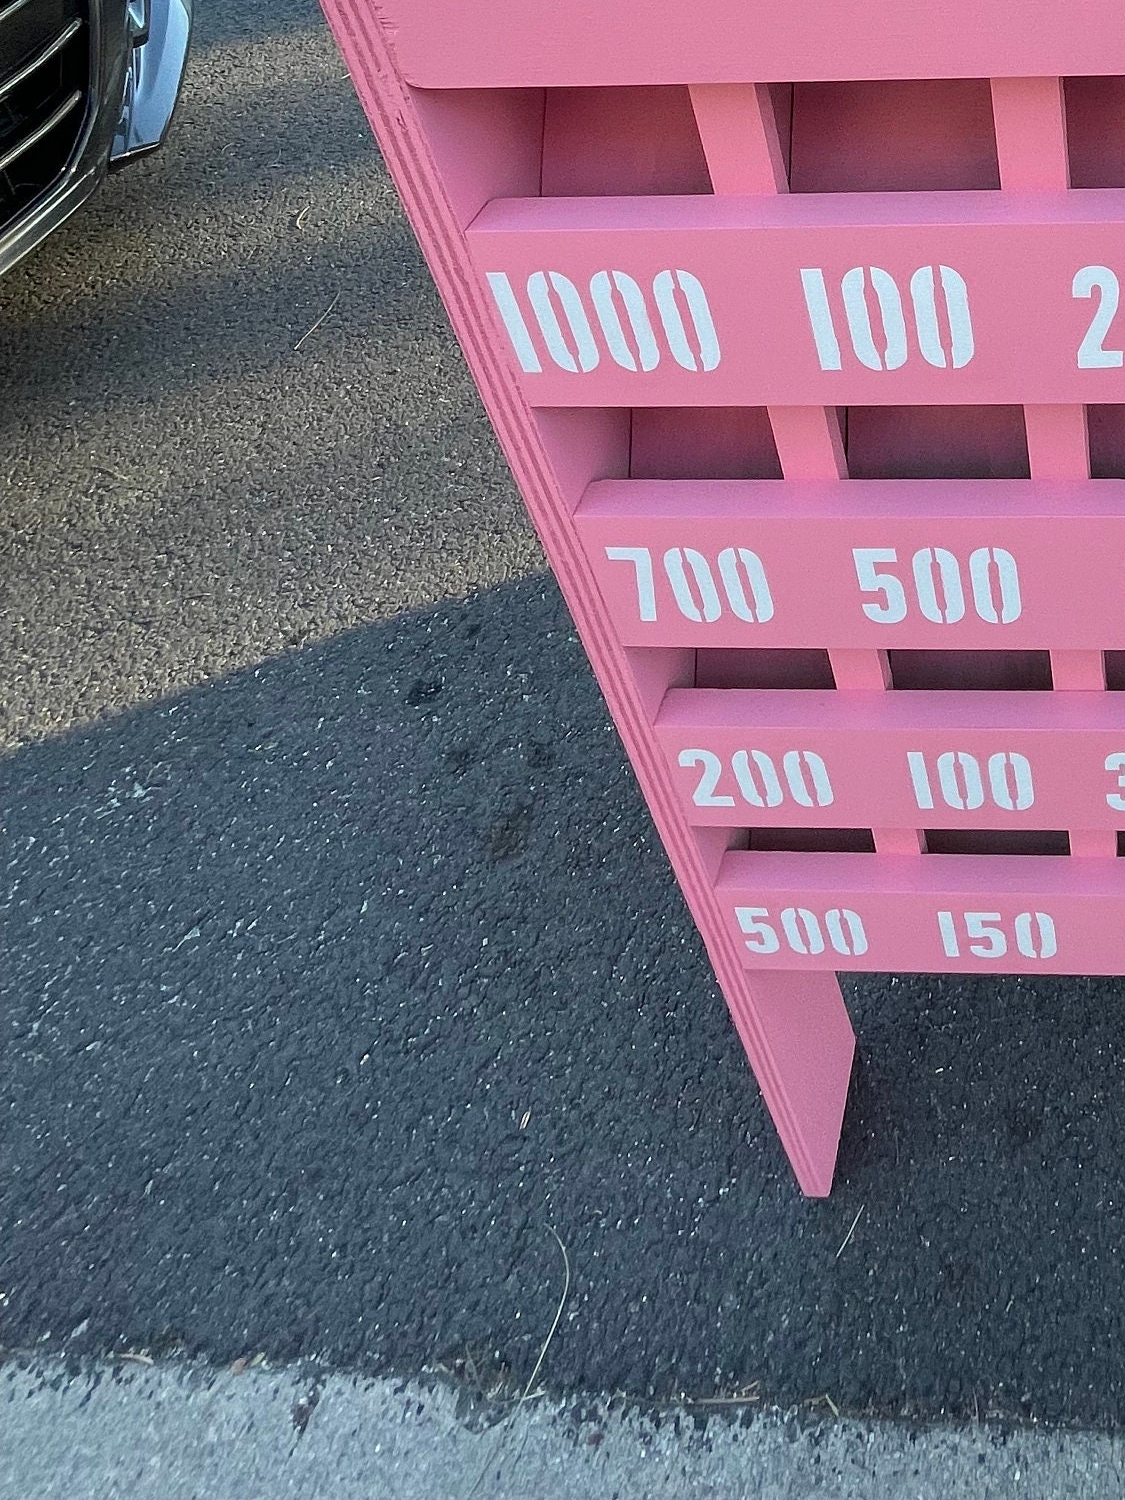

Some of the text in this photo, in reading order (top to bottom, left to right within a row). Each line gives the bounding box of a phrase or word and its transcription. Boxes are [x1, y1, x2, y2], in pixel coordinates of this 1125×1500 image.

[486, 270, 721, 373] 1000
[800, 265, 975, 371] 100
[605, 547, 774, 623] 700
[852, 548, 1022, 624] 500
[678, 749, 834, 808] 200
[907, 751, 1035, 810] 100
[735, 907, 868, 956] 500
[937, 911, 1058, 959] 150
